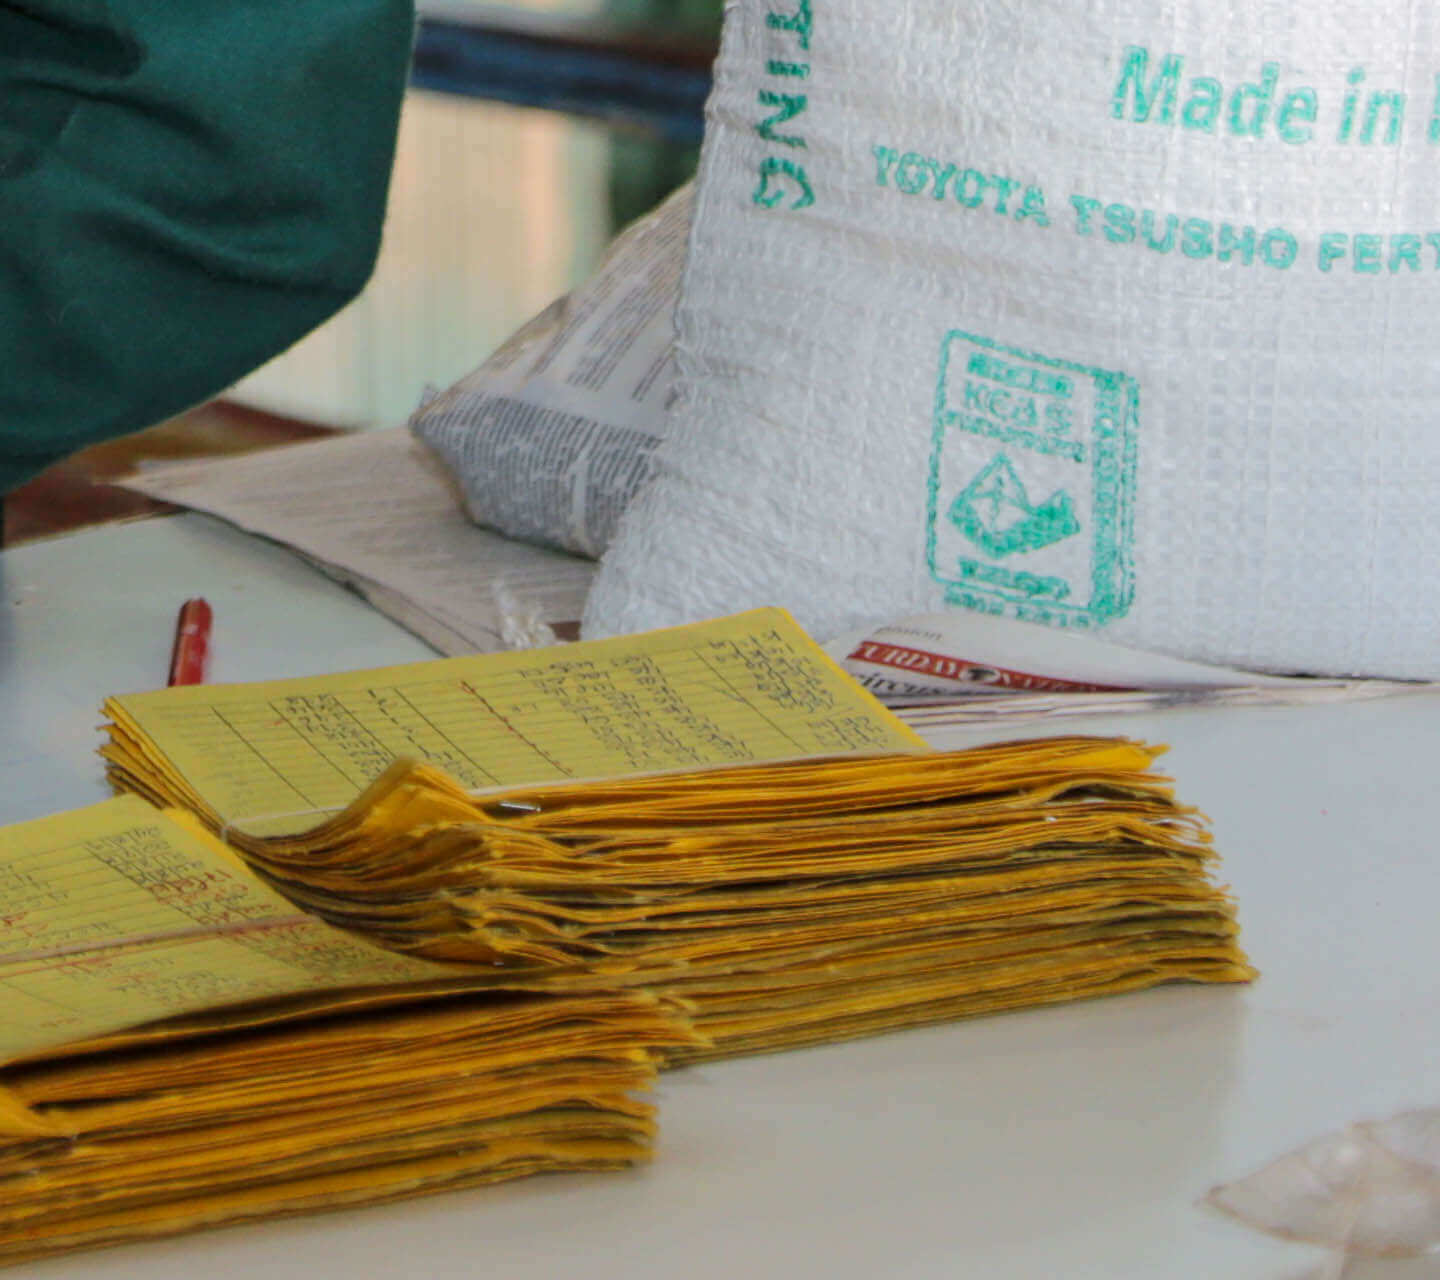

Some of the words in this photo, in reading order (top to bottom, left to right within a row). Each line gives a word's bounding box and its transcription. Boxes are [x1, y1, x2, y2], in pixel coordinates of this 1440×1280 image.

[1110, 45, 1319, 143] Made
[1336, 66, 1407, 146] in
[872, 144, 1051, 228] TOYOTA
[1069, 193, 1300, 271] TSUSHO
